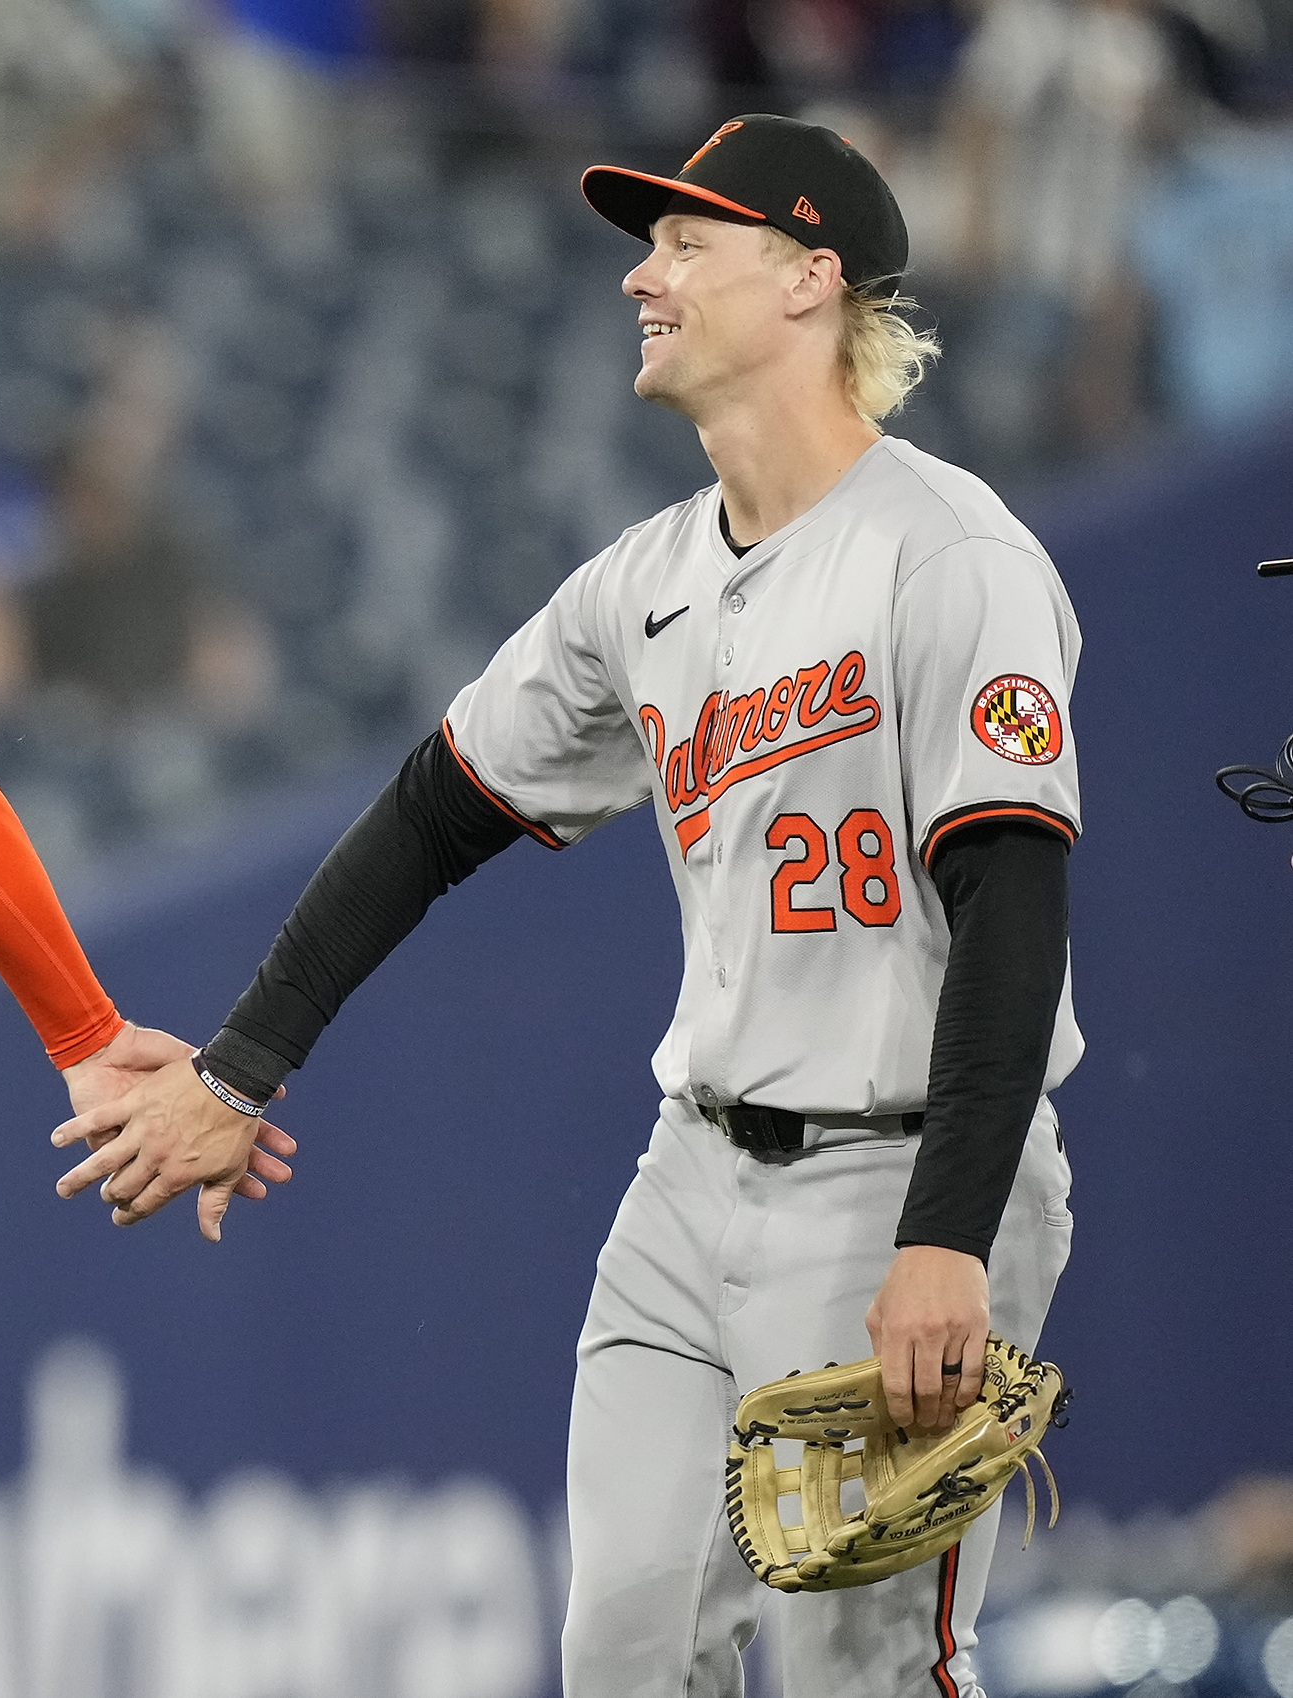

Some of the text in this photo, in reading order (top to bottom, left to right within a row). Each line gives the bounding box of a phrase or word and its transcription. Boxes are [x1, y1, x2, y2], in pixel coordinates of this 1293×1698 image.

[977, 678, 1055, 714] BALTIMORE
[993, 746, 1055, 763] ORIOLES
[766, 808, 902, 934] 28
[932, 1511, 955, 1527] GOLD
